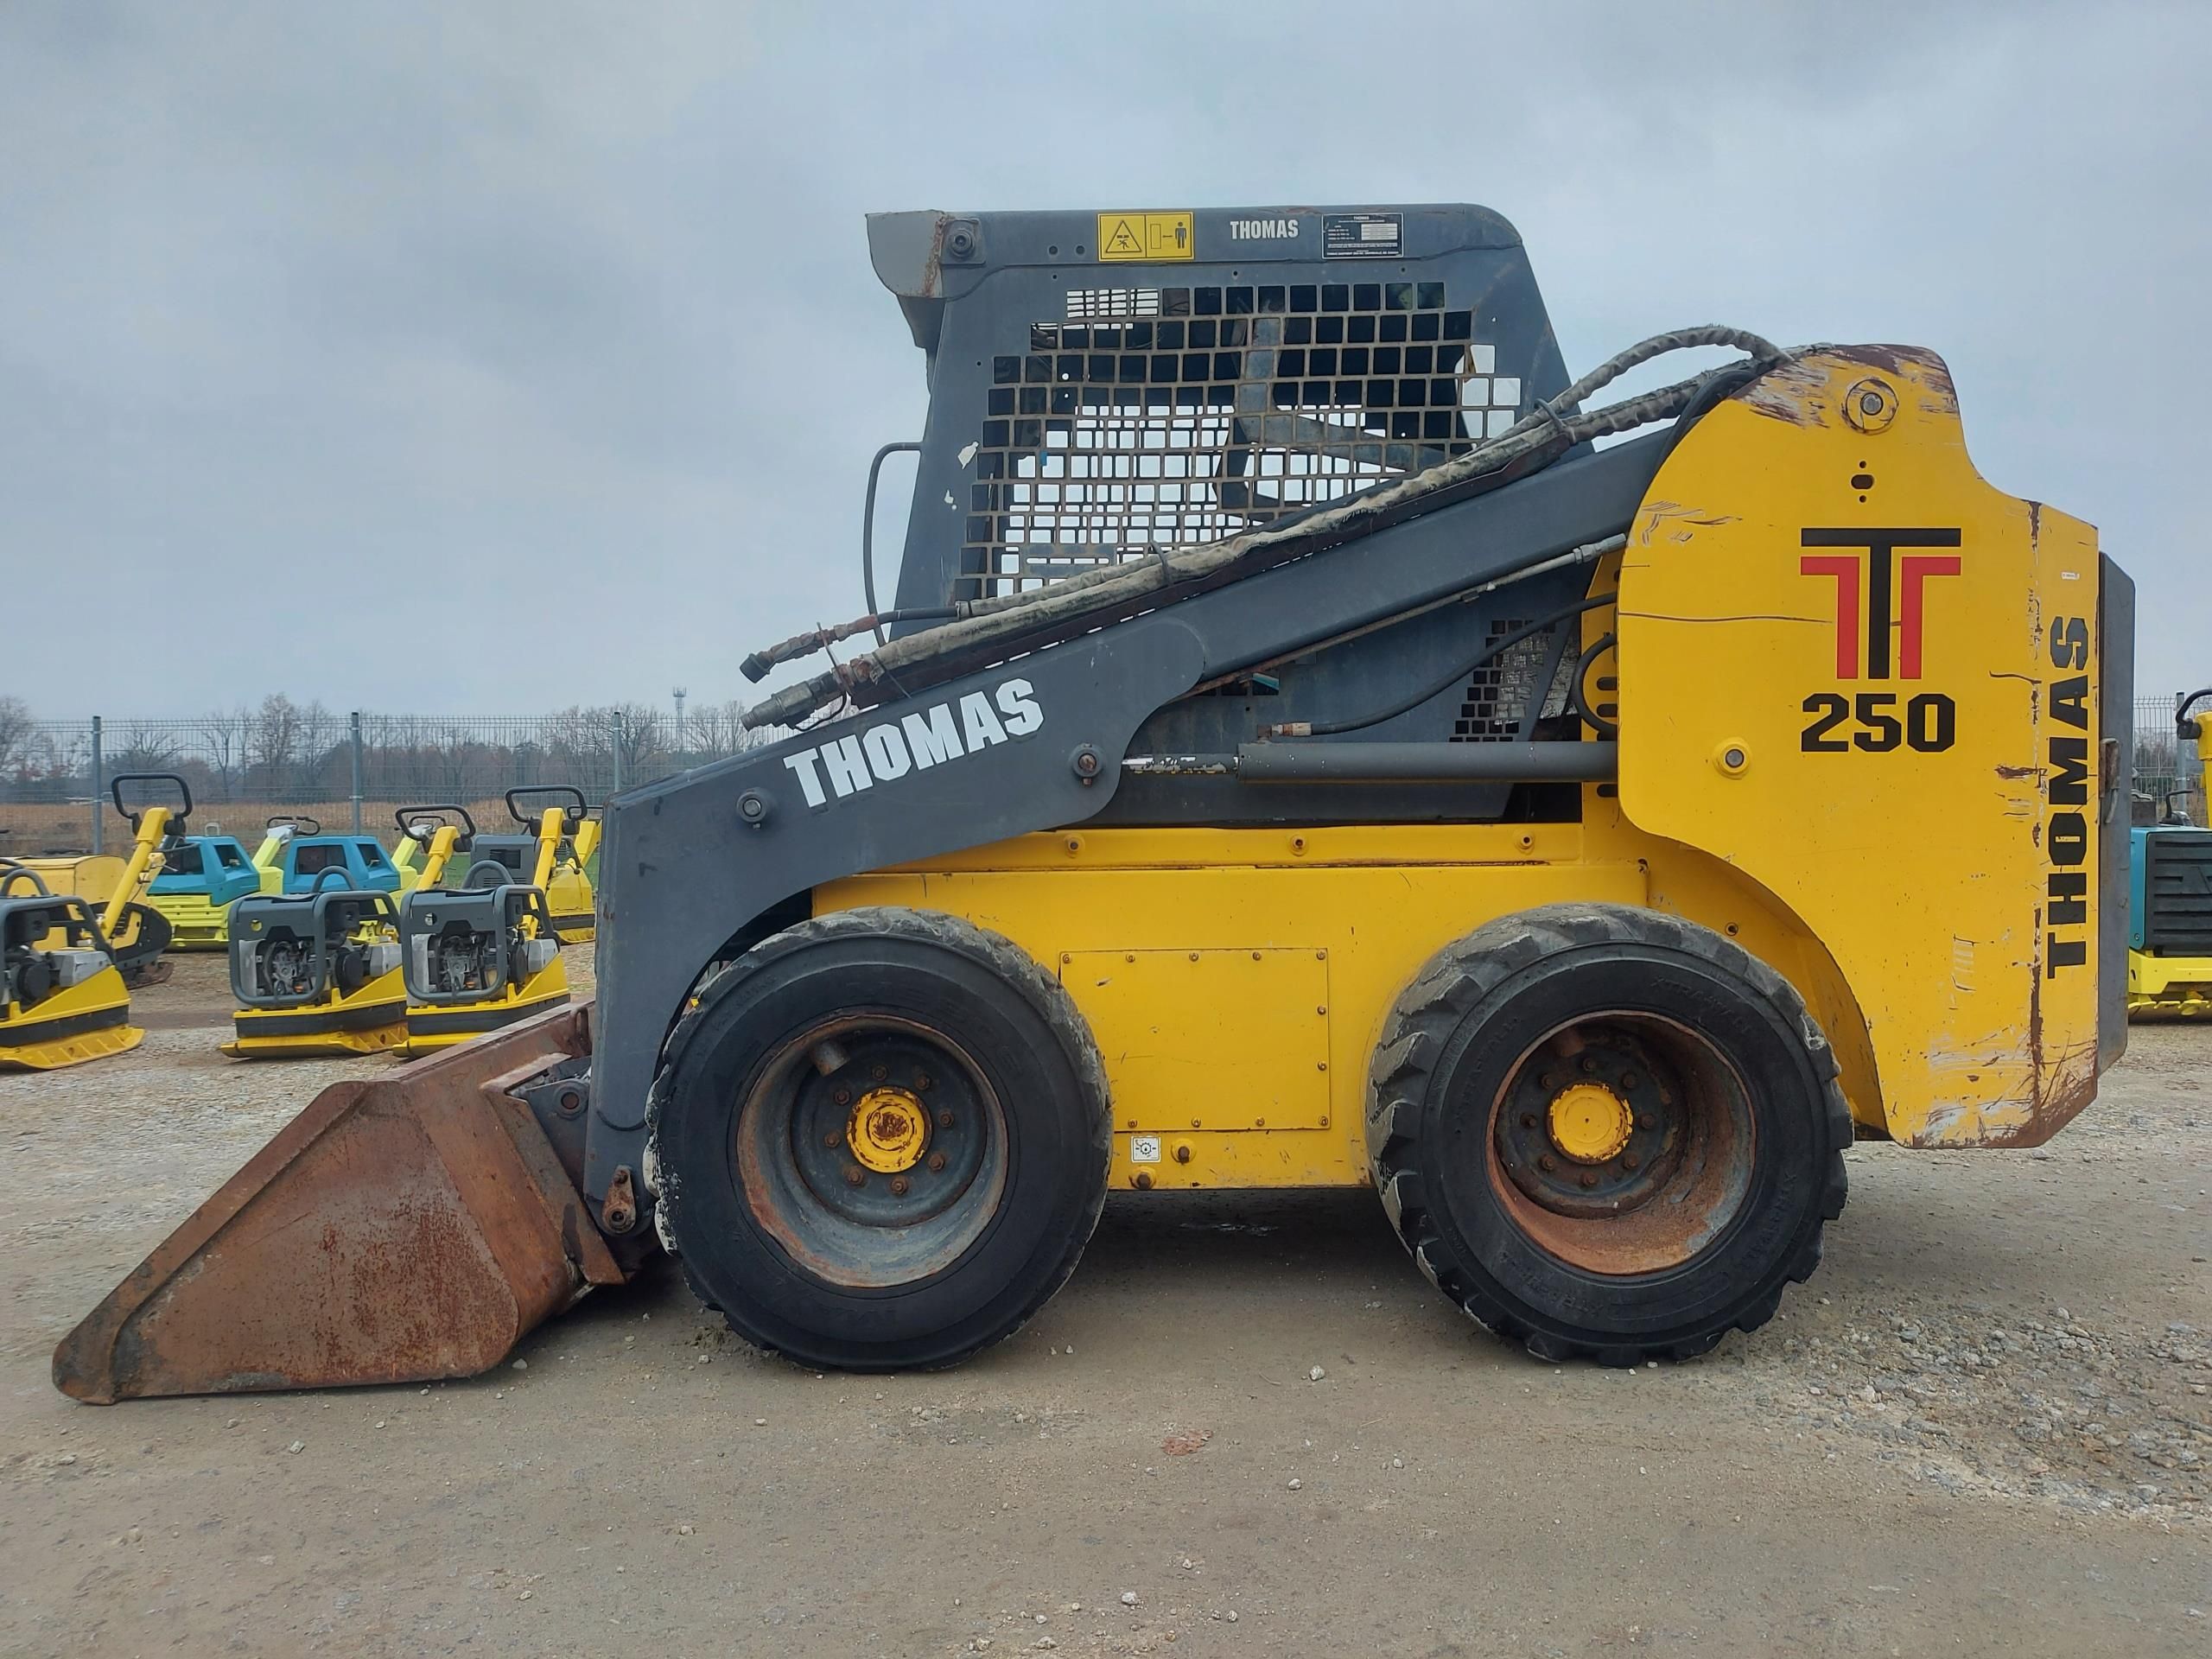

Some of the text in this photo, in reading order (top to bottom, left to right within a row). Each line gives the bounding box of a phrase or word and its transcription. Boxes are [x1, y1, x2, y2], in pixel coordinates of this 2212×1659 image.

[1230, 219, 1299, 240] THOMAS
[783, 677, 1045, 808] THOMAS
[1801, 693, 1956, 753] 250
[2048, 616, 2089, 979] THOMAS
